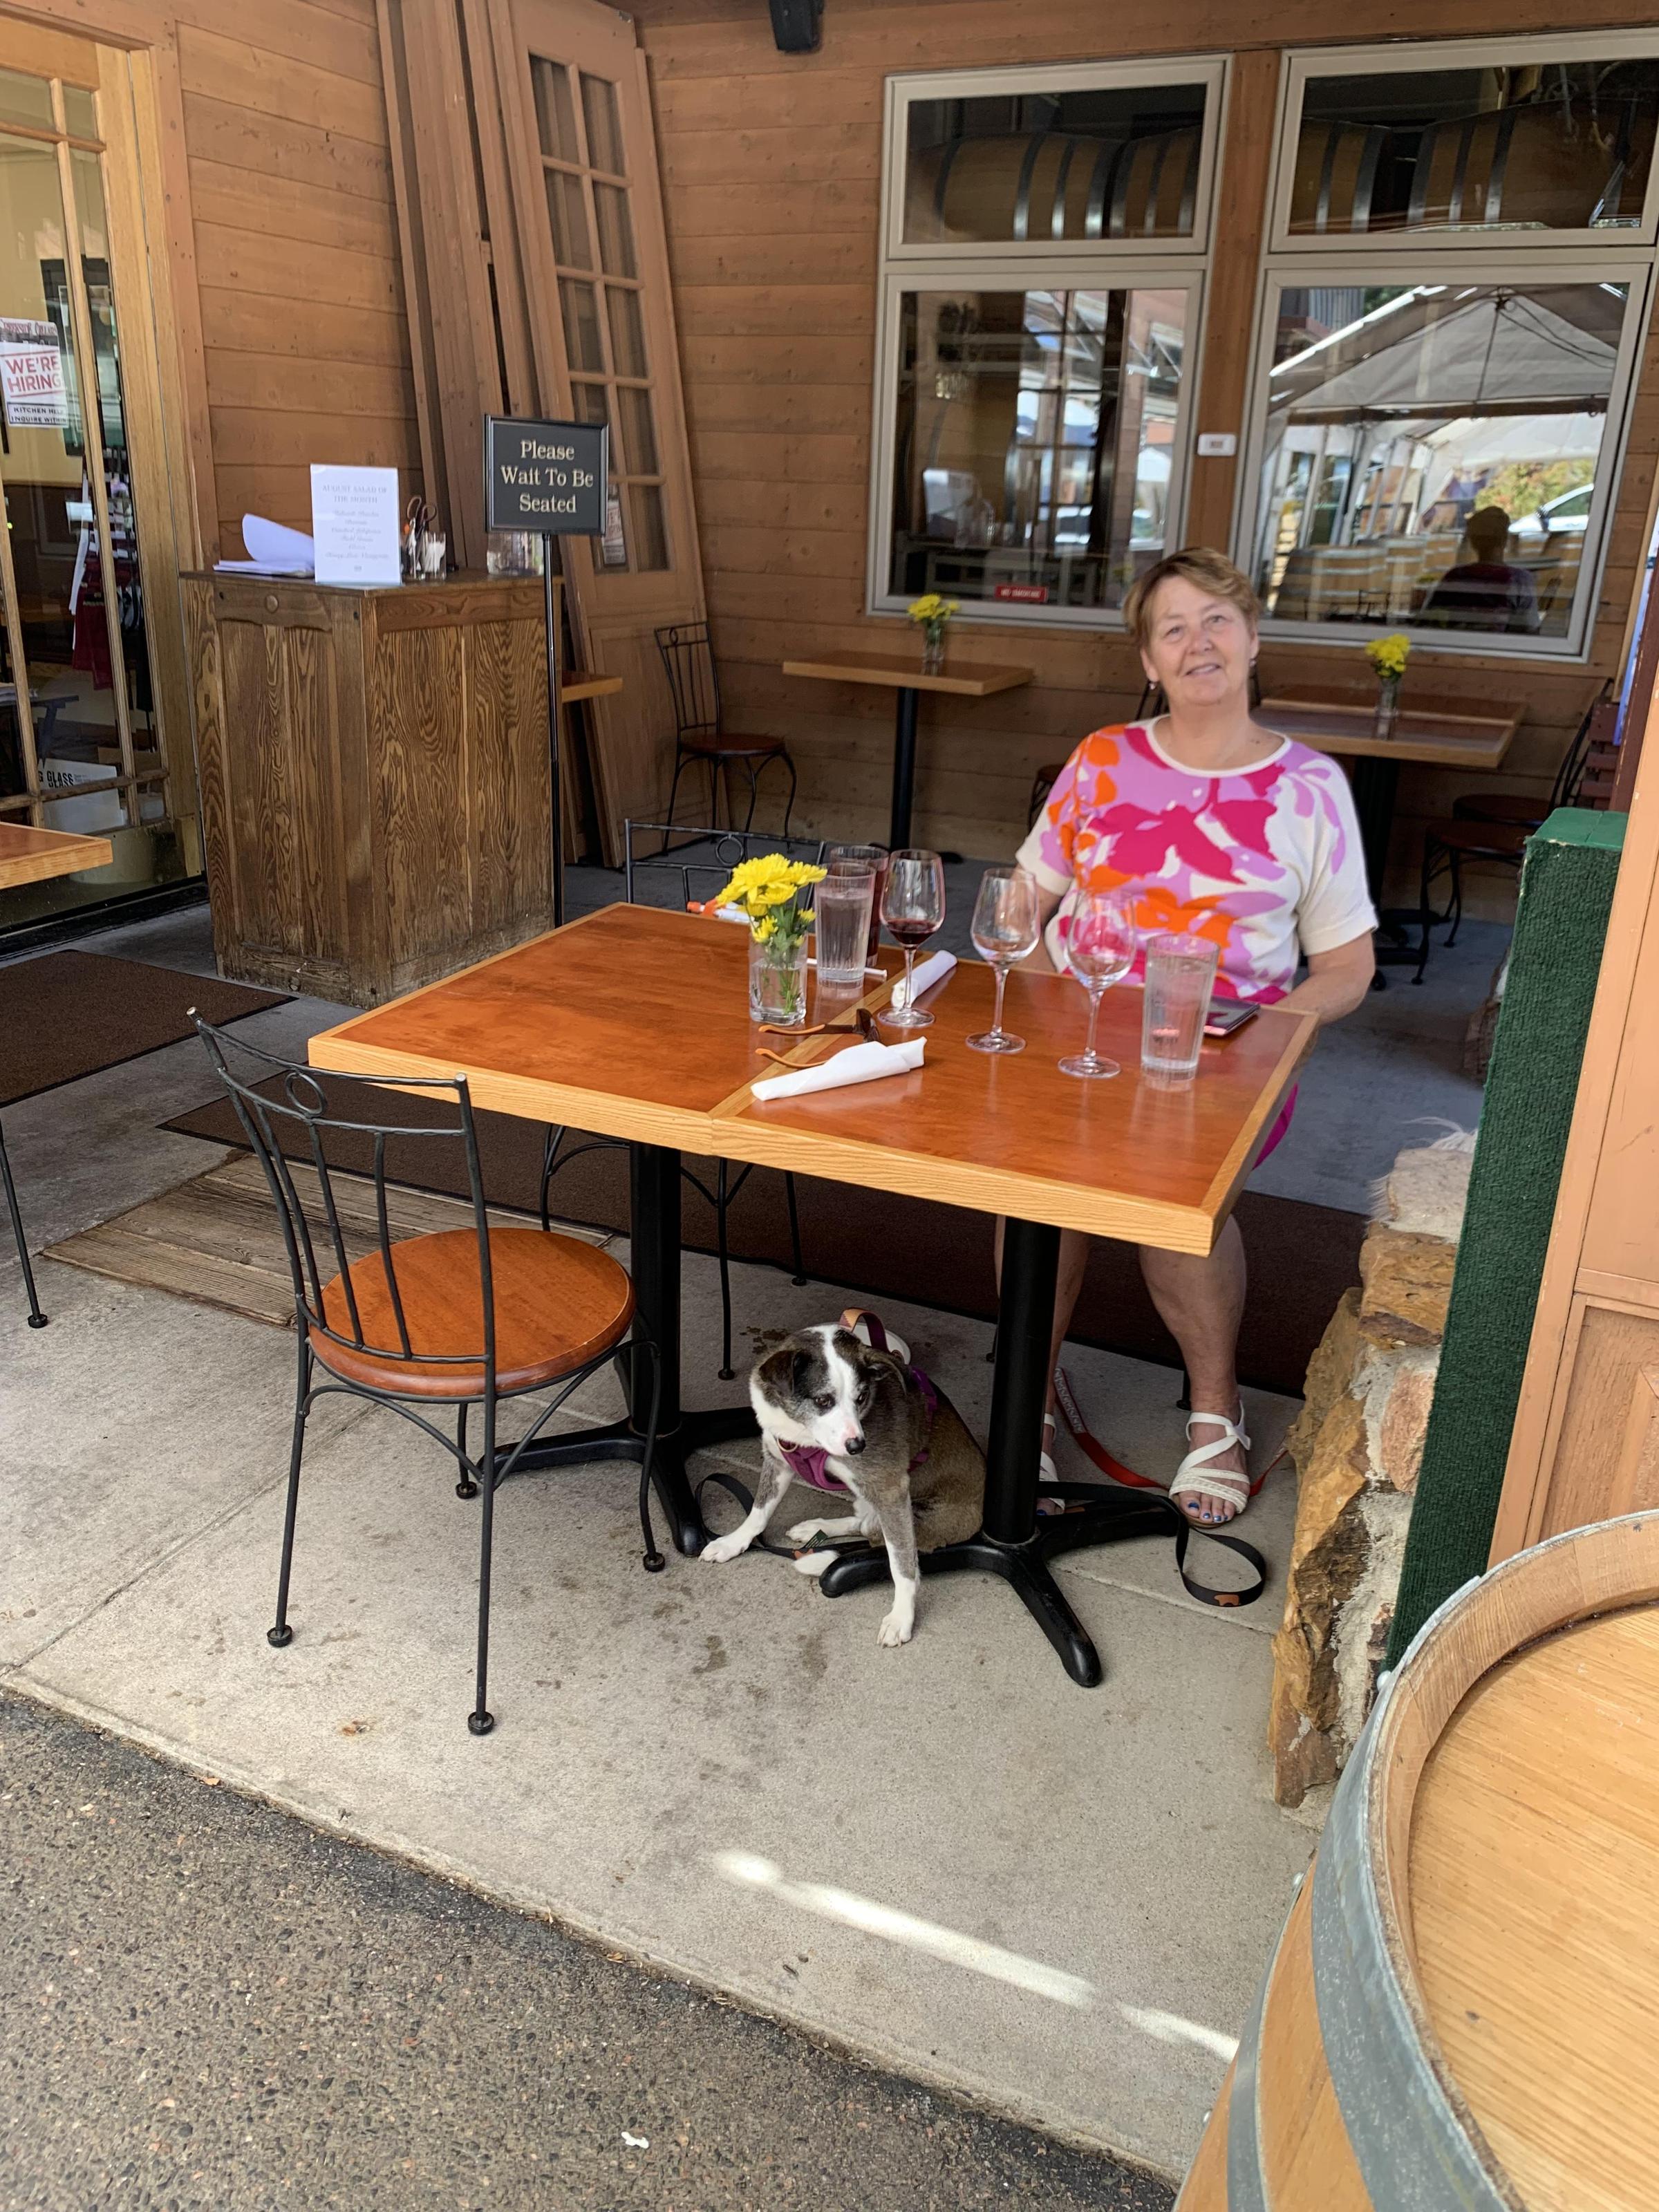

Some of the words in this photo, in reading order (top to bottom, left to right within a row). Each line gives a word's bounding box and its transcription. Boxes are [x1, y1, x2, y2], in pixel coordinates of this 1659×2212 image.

[5, 356, 60, 374] WE'RE
[7, 374, 61, 393] HIRING
[520, 439, 575, 461] Please
[500, 464, 542, 486] Wait
[545, 466, 567, 487] To
[572, 469, 594, 488] Be
[518, 491, 577, 514] Seated
[46, 770, 74, 787] GLASS
